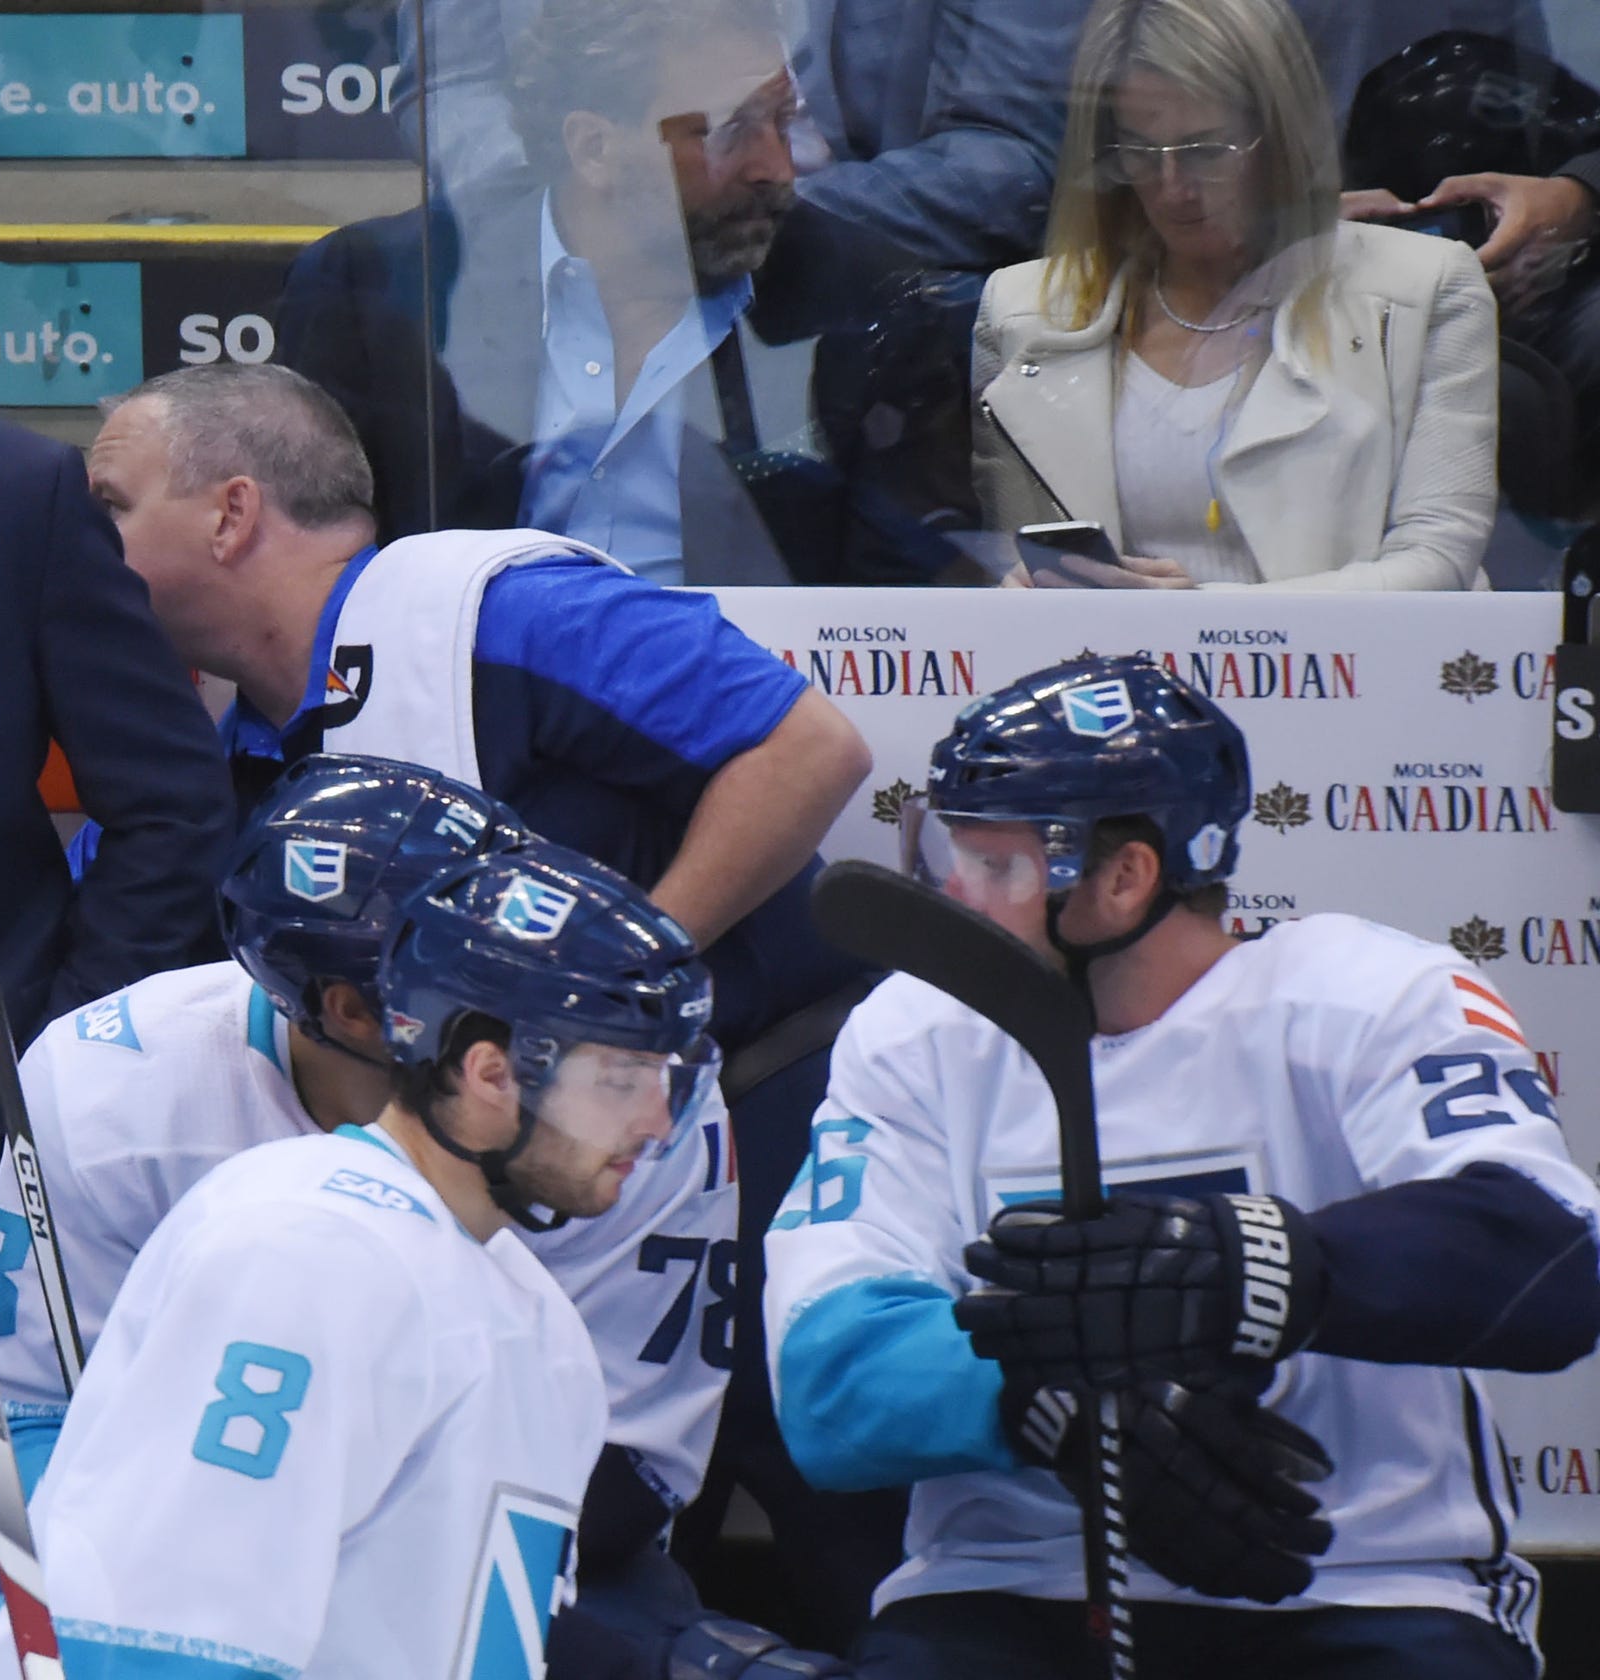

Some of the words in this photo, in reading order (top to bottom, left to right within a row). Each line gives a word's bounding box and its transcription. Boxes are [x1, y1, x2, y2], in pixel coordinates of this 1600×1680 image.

[68, 71, 217, 115] auto.
[817, 627, 907, 642] MOLSON
[1198, 630, 1288, 645] MOLSON
[780, 649, 975, 696] NADIAN
[1393, 763, 1483, 779] MOLSON
[434, 801, 488, 847] 78
[1325, 783, 1552, 832] CANADIAN
[17, 1152, 49, 1240] CCM
[326, 1172, 413, 1211] SAP
[193, 1340, 313, 1480] 8
